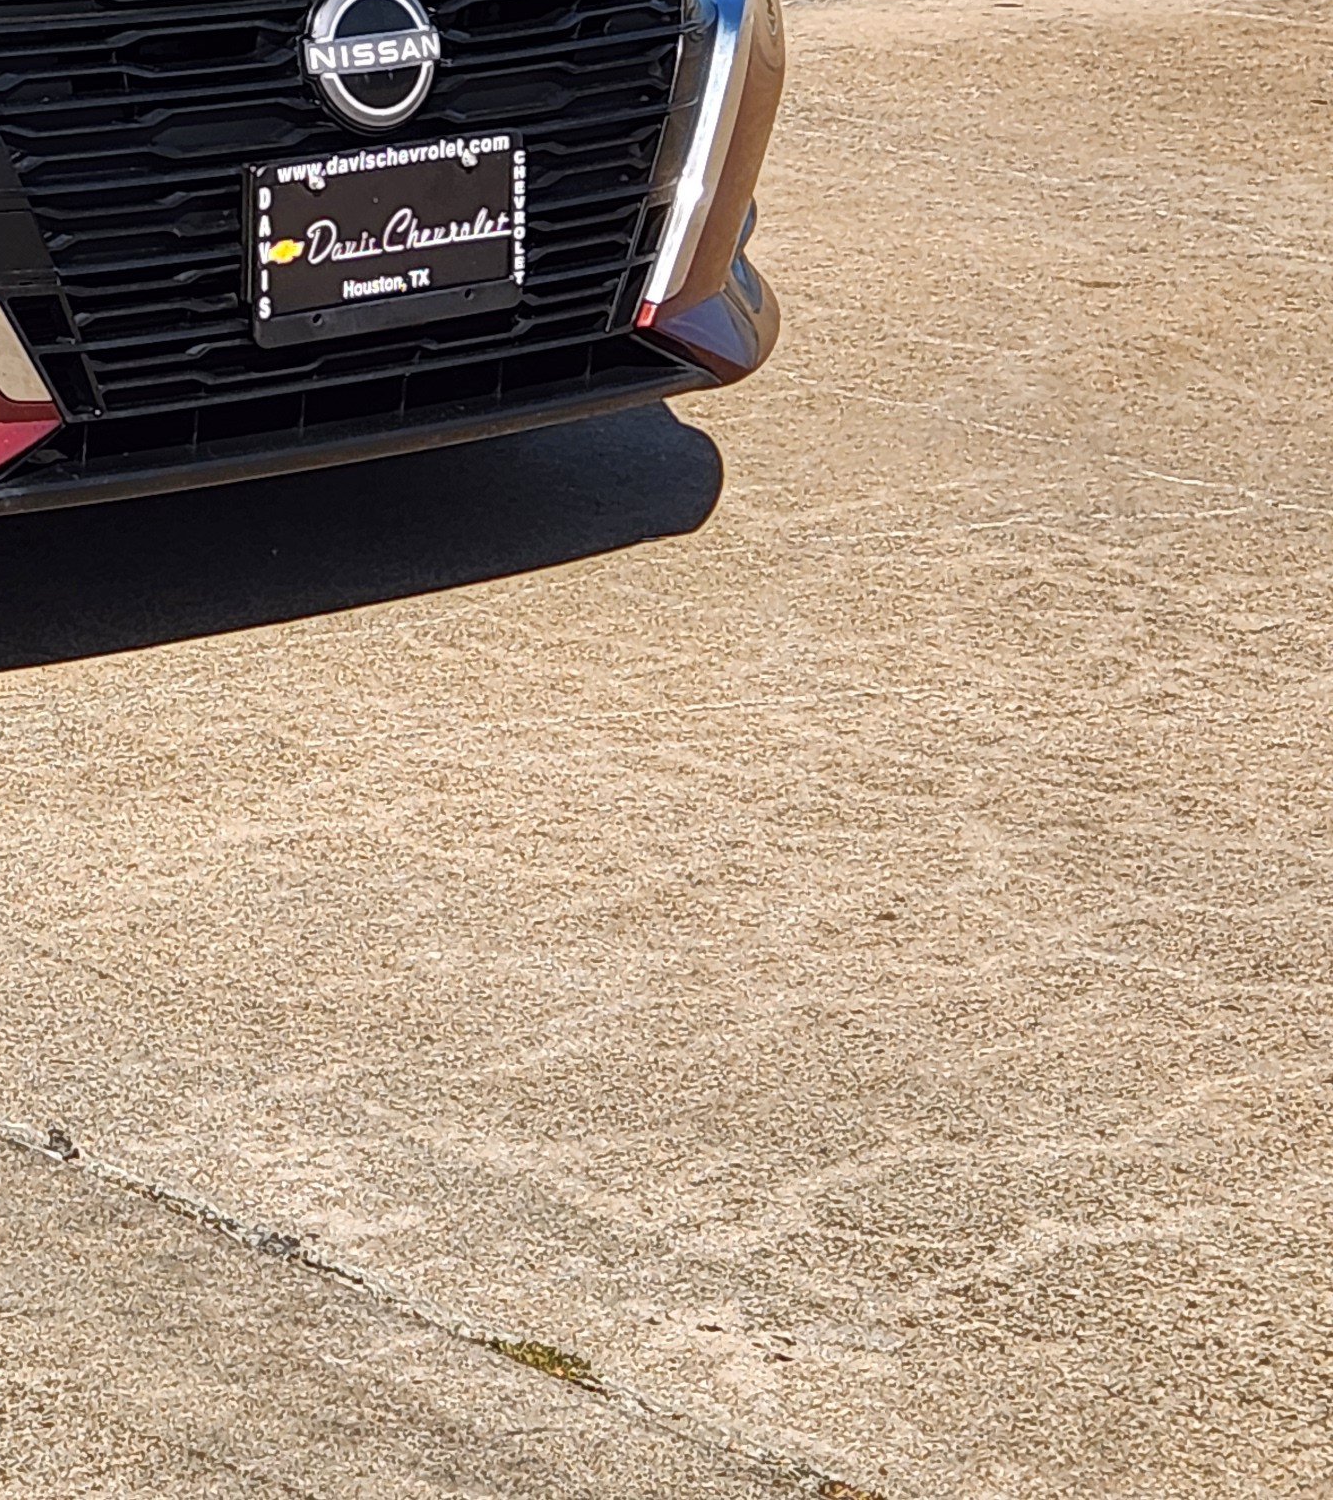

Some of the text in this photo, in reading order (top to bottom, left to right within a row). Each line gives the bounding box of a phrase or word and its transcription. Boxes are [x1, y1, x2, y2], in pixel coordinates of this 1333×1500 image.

[309, 33, 440, 70] NISSAN
[277, 136, 510, 183] www.davischevrolet.com
[307, 207, 512, 264] Davis Chevrolet
[514, 151, 526, 286] CHEVROLET
[258, 187, 271, 320] DAVIS
[343, 268, 431, 300] Houston, TX
